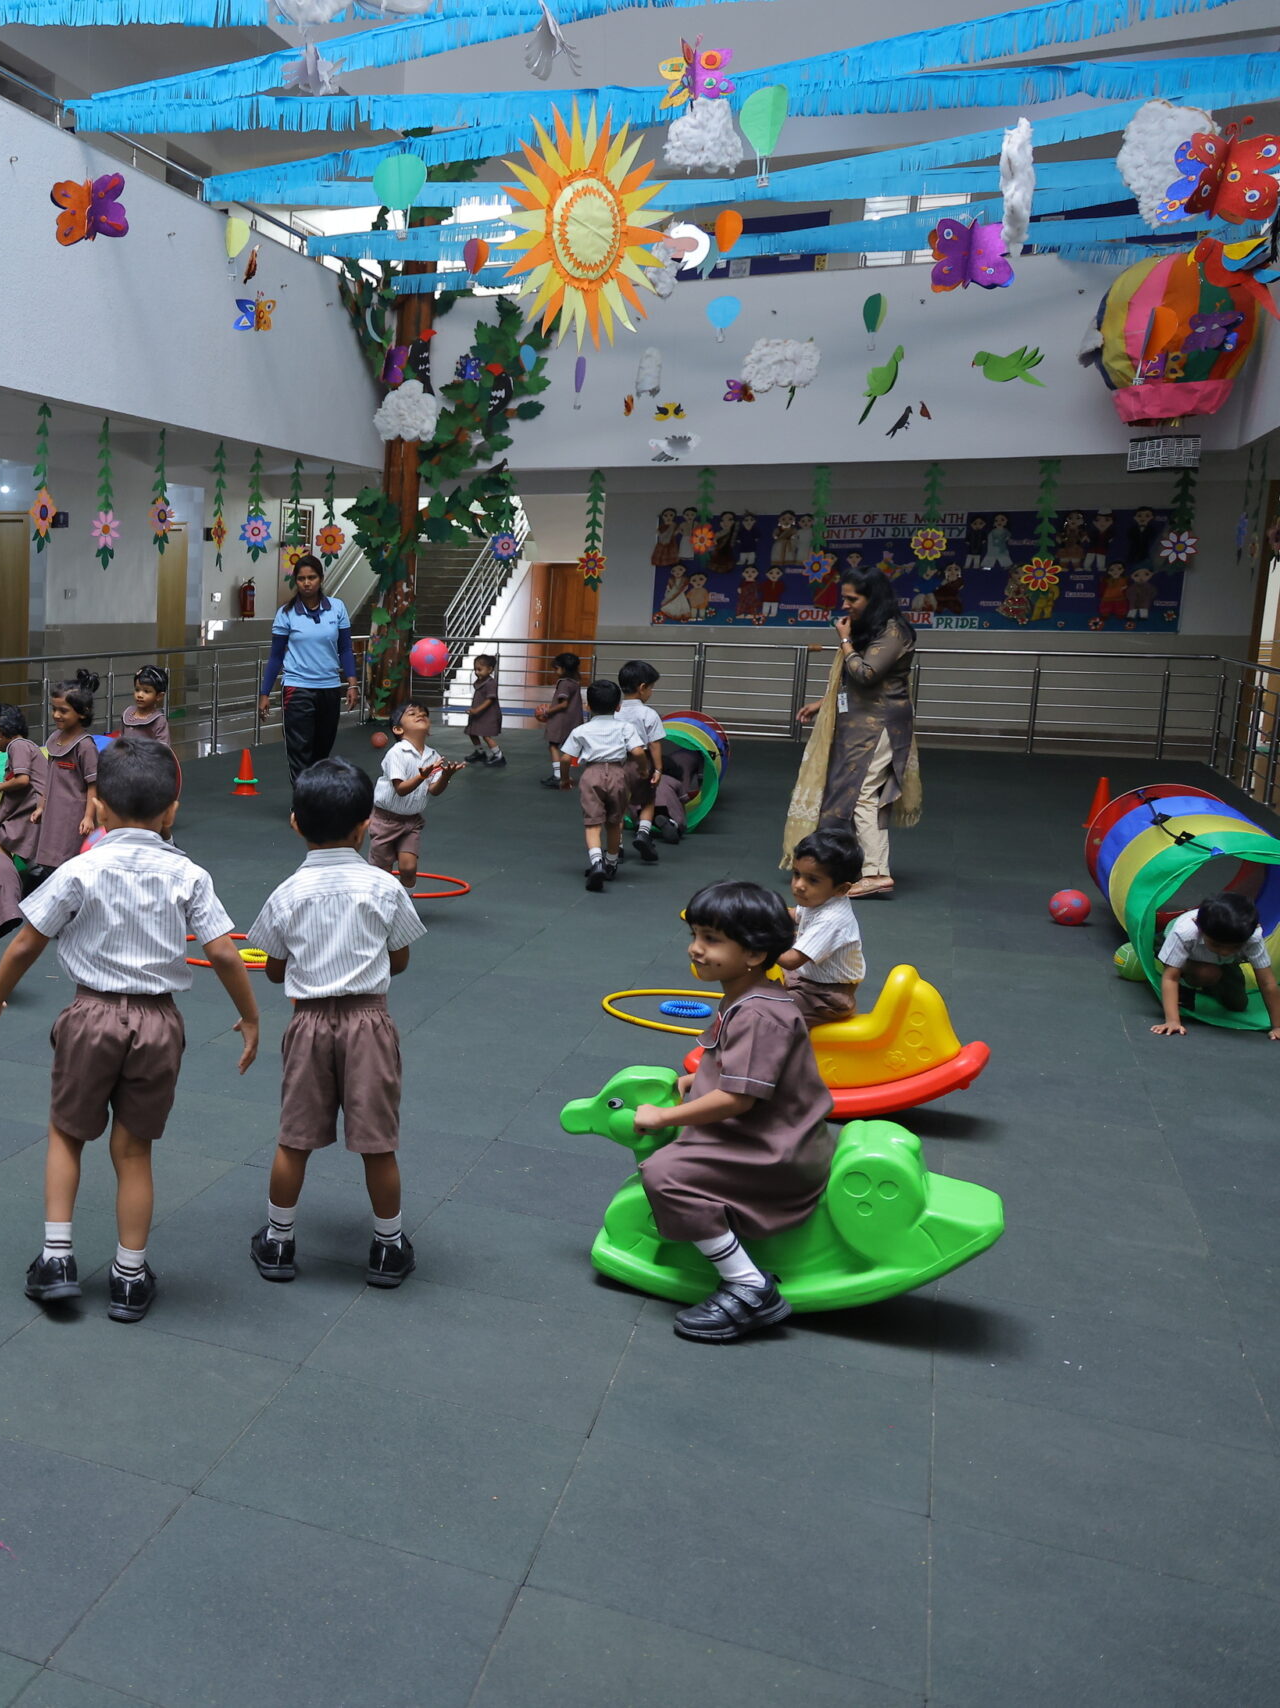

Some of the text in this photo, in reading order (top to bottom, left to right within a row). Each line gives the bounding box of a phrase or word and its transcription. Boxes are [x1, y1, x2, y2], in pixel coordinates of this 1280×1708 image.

[824, 512, 964, 524] HEME OF THE MNTH
[822, 527, 868, 540] UNITY
[871, 527, 887, 538] IN
[798, 609, 829, 621] OUR
[935, 615, 979, 629] PRIDE
